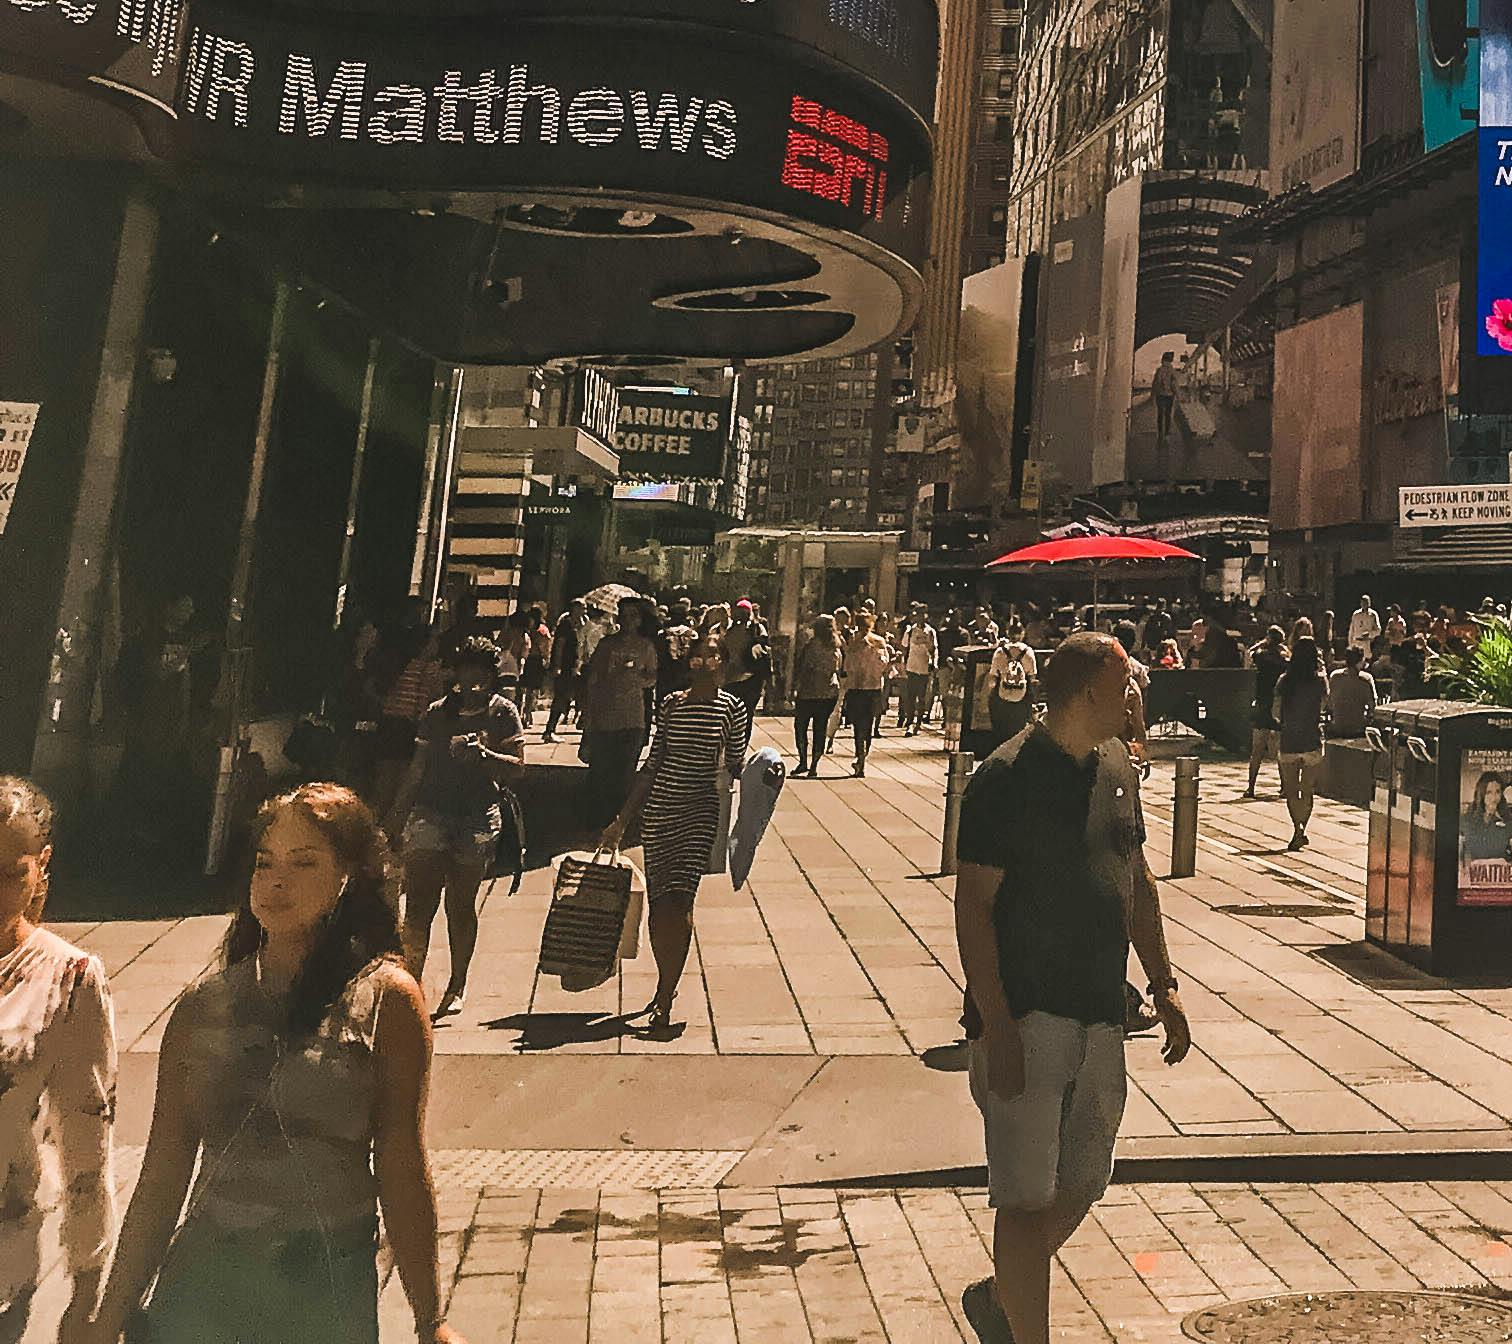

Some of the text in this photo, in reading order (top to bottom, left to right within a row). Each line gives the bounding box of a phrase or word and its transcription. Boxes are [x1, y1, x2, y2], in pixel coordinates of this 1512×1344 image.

[278, 53, 739, 160] Matthews
[617, 405, 720, 432] ARBUCKS
[611, 431, 692, 455] COFFEE
[1403, 489, 1511, 506] PEDESTRIAN FLOW ZONE
[1452, 505, 1512, 520] KEEP MOVING
